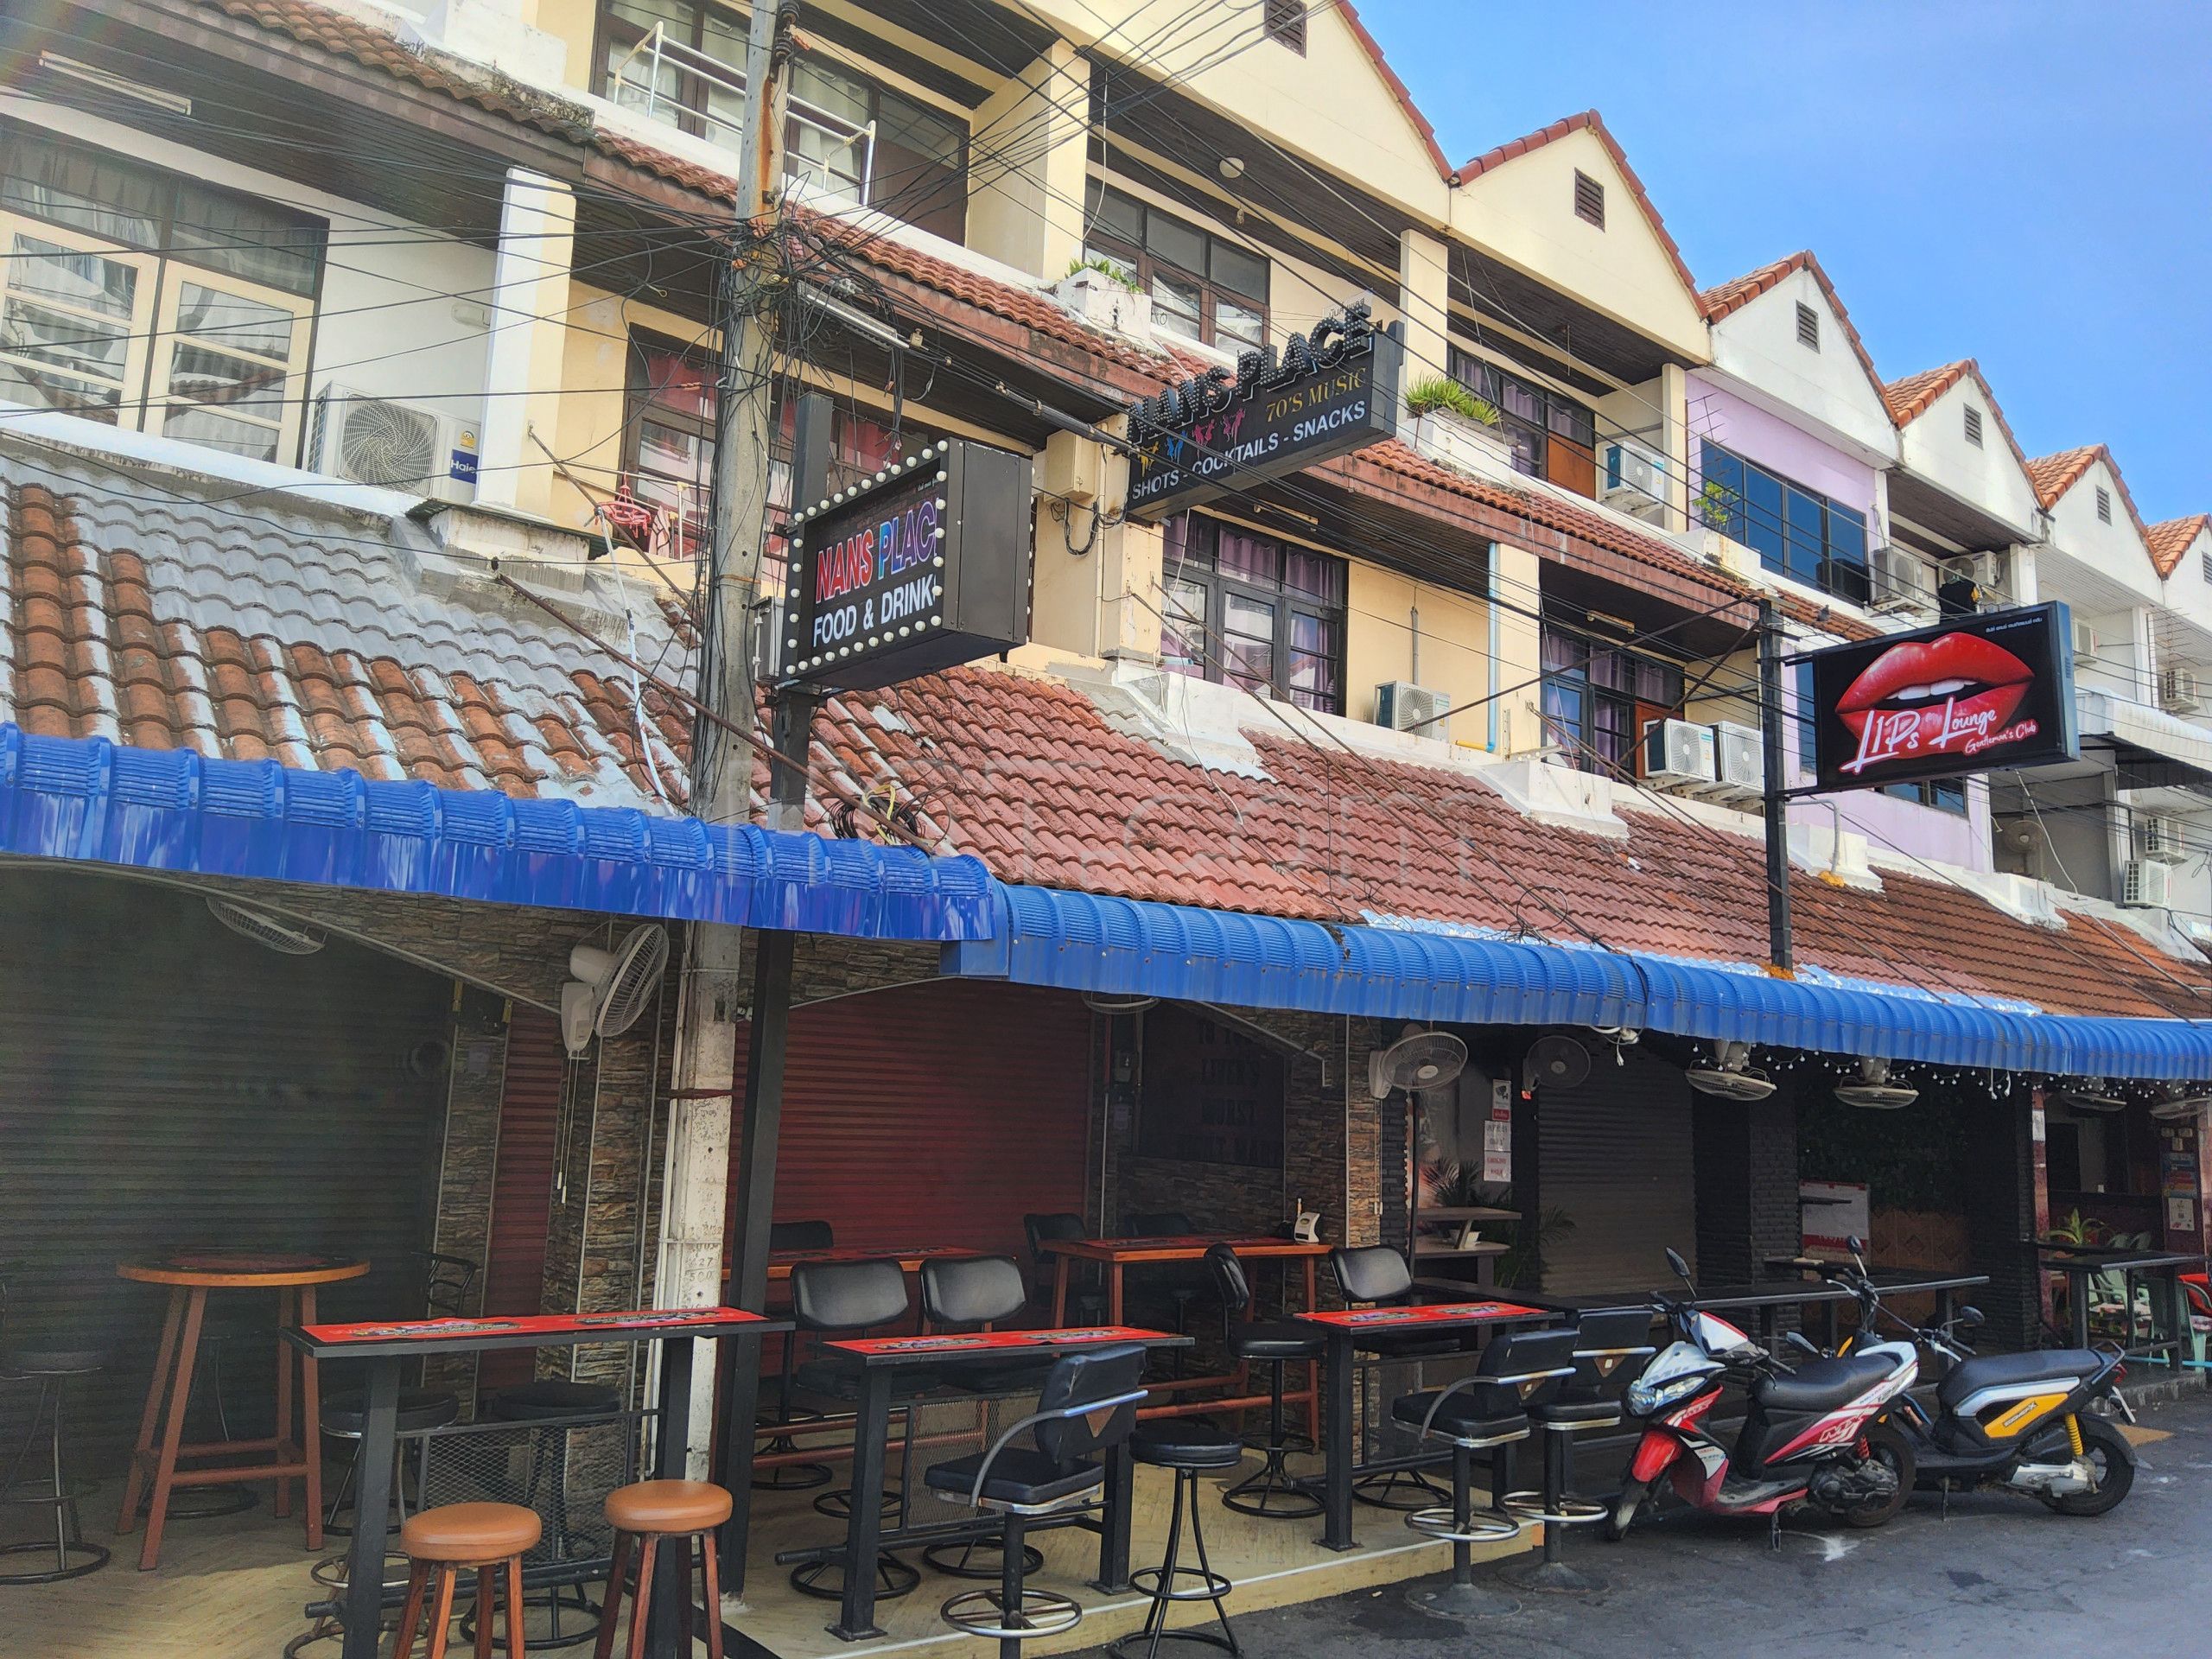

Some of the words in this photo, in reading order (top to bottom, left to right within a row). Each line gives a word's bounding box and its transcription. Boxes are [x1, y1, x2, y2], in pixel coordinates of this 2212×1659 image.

[1236, 303, 1371, 396] PLACE
[1266, 392, 1303, 423] 70'S
[1307, 366, 1367, 402] MUSIC
[450, 459, 477, 474] Haie
[1132, 469, 1179, 499] SHOTS
[1192, 432, 1279, 475] COCKTAILS
[1293, 400, 1366, 442] SNACKS
[816, 529, 874, 604] NANS
[878, 498, 939, 580] PLAC
[813, 606, 857, 647] FOOD
[863, 598, 874, 631] &
[880, 574, 937, 625] DRINK
[1928, 696, 1997, 749] Lounge
[2015, 721, 2037, 739] Club
